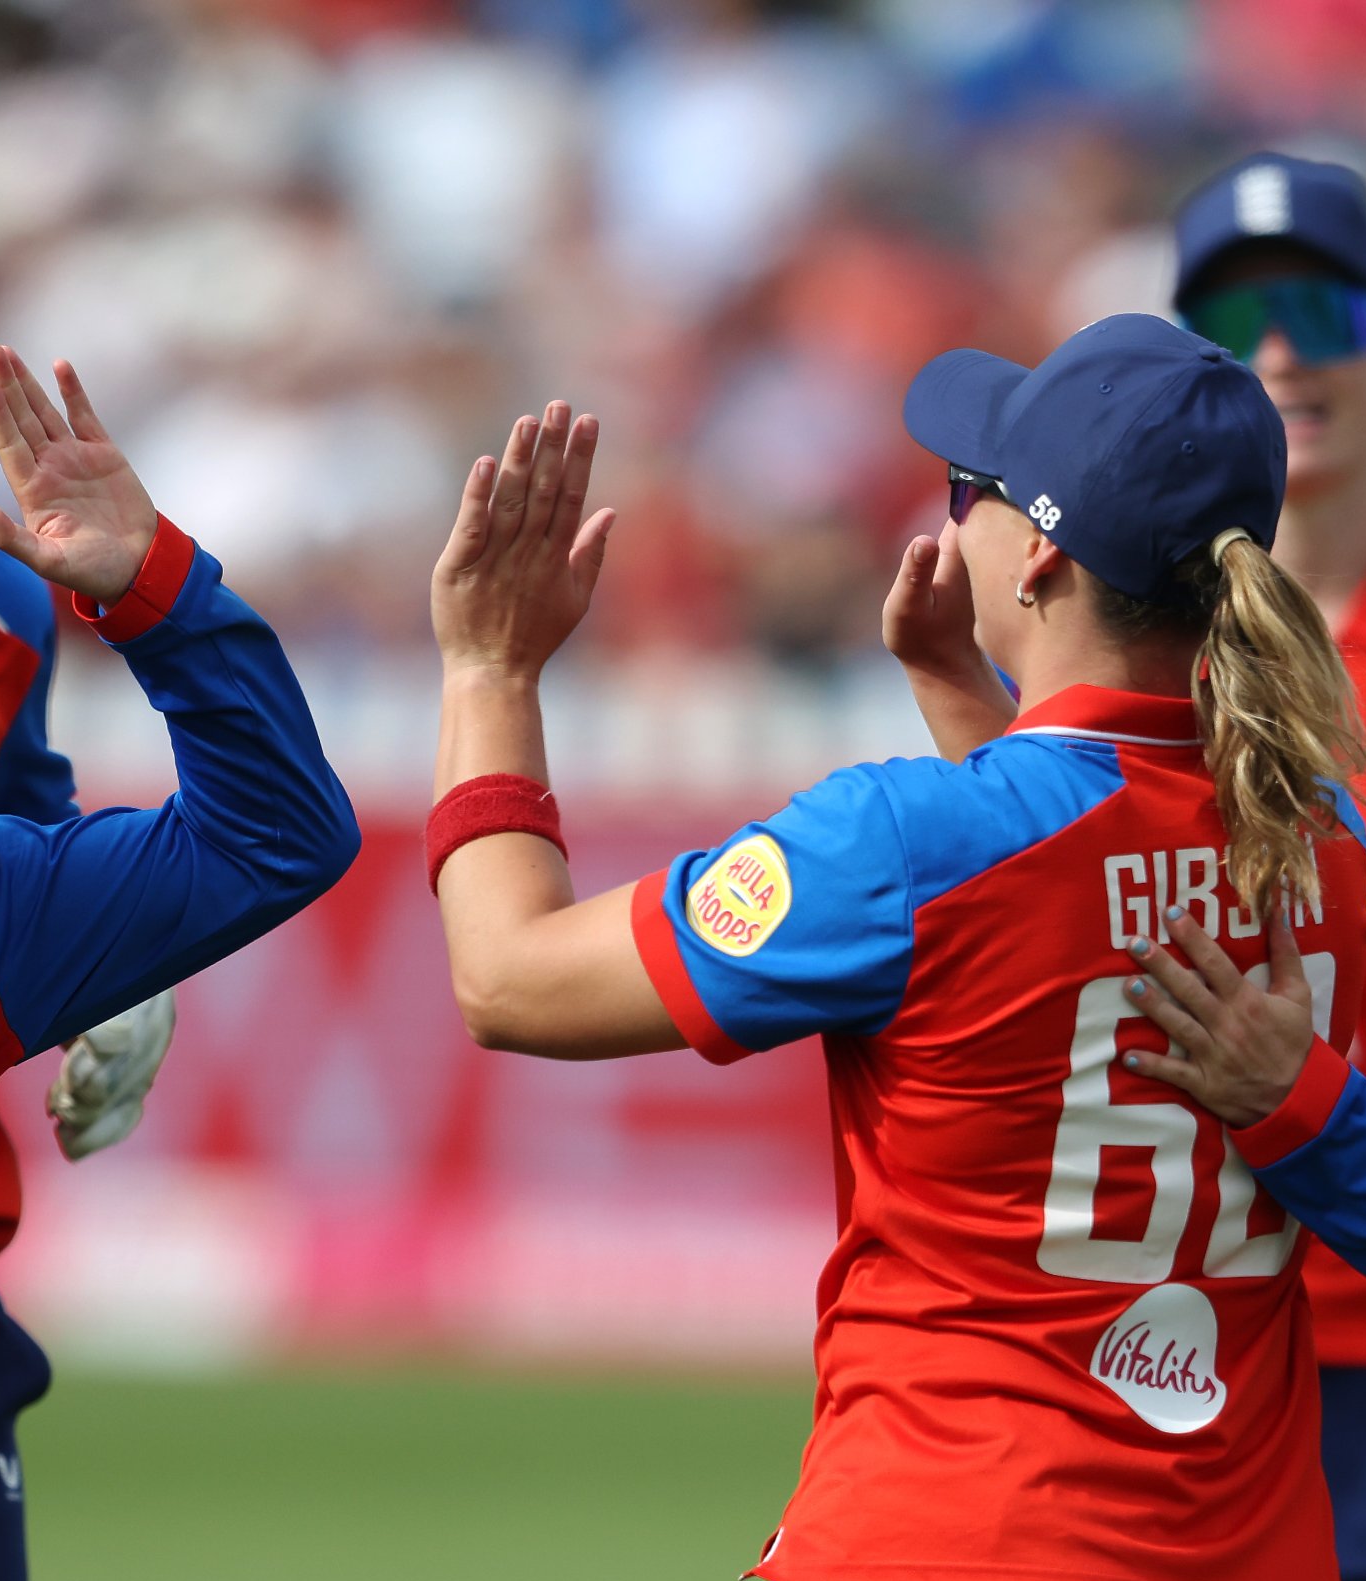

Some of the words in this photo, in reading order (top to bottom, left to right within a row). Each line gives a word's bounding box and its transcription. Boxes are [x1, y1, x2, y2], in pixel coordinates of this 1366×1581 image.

[1029, 494, 1062, 531] 58
[697, 880, 761, 945] HOOPS
[726, 855, 775, 911] HULA
[1104, 832, 1323, 950] GIBSN
[1098, 1320, 1218, 1405] Vitality
